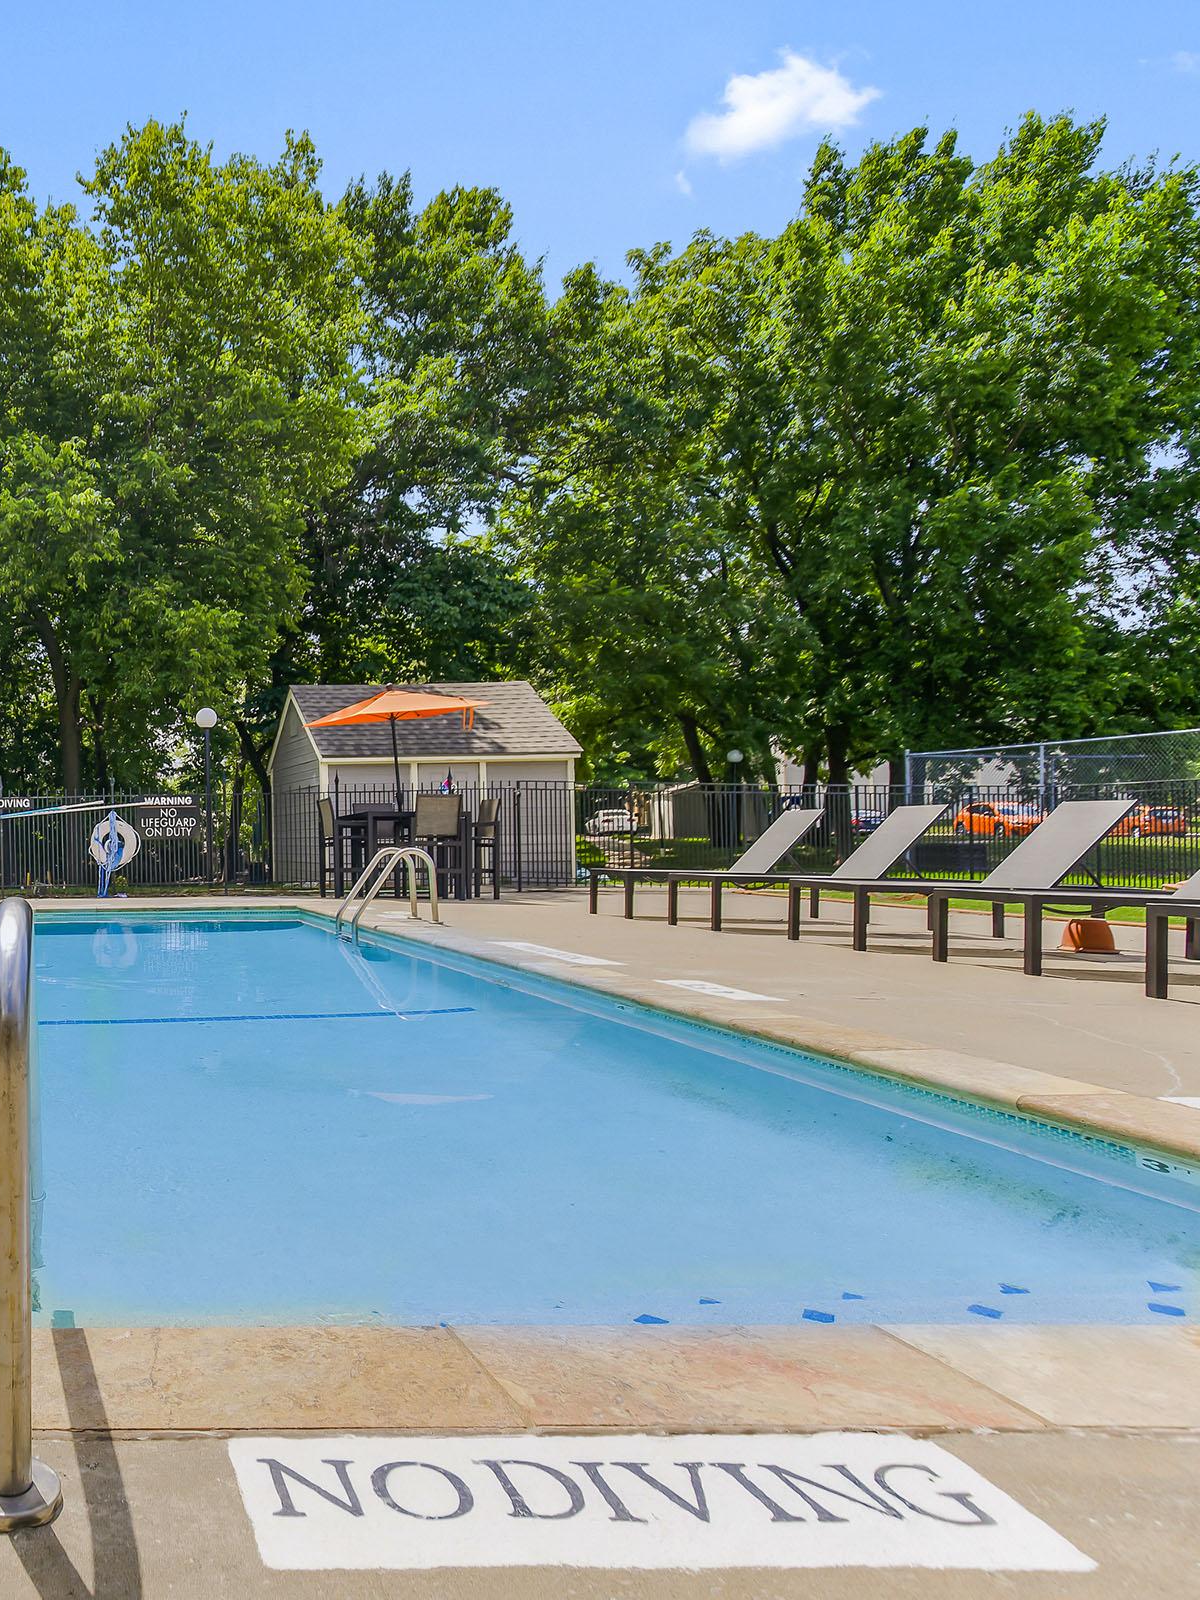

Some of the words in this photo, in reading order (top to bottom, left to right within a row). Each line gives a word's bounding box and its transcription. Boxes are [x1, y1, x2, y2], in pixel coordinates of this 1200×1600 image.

[144, 796, 193, 805] WARNING
[160, 808, 177, 818] NO
[141, 817, 197, 828] LIFEGUARD
[145, 827, 162, 837] ON
[166, 827, 192, 837] DUTY
[1141, 1157, 1171, 1174] 3
[255, 1458, 476, 1521] NO
[471, 1459, 999, 1528] DIVING
